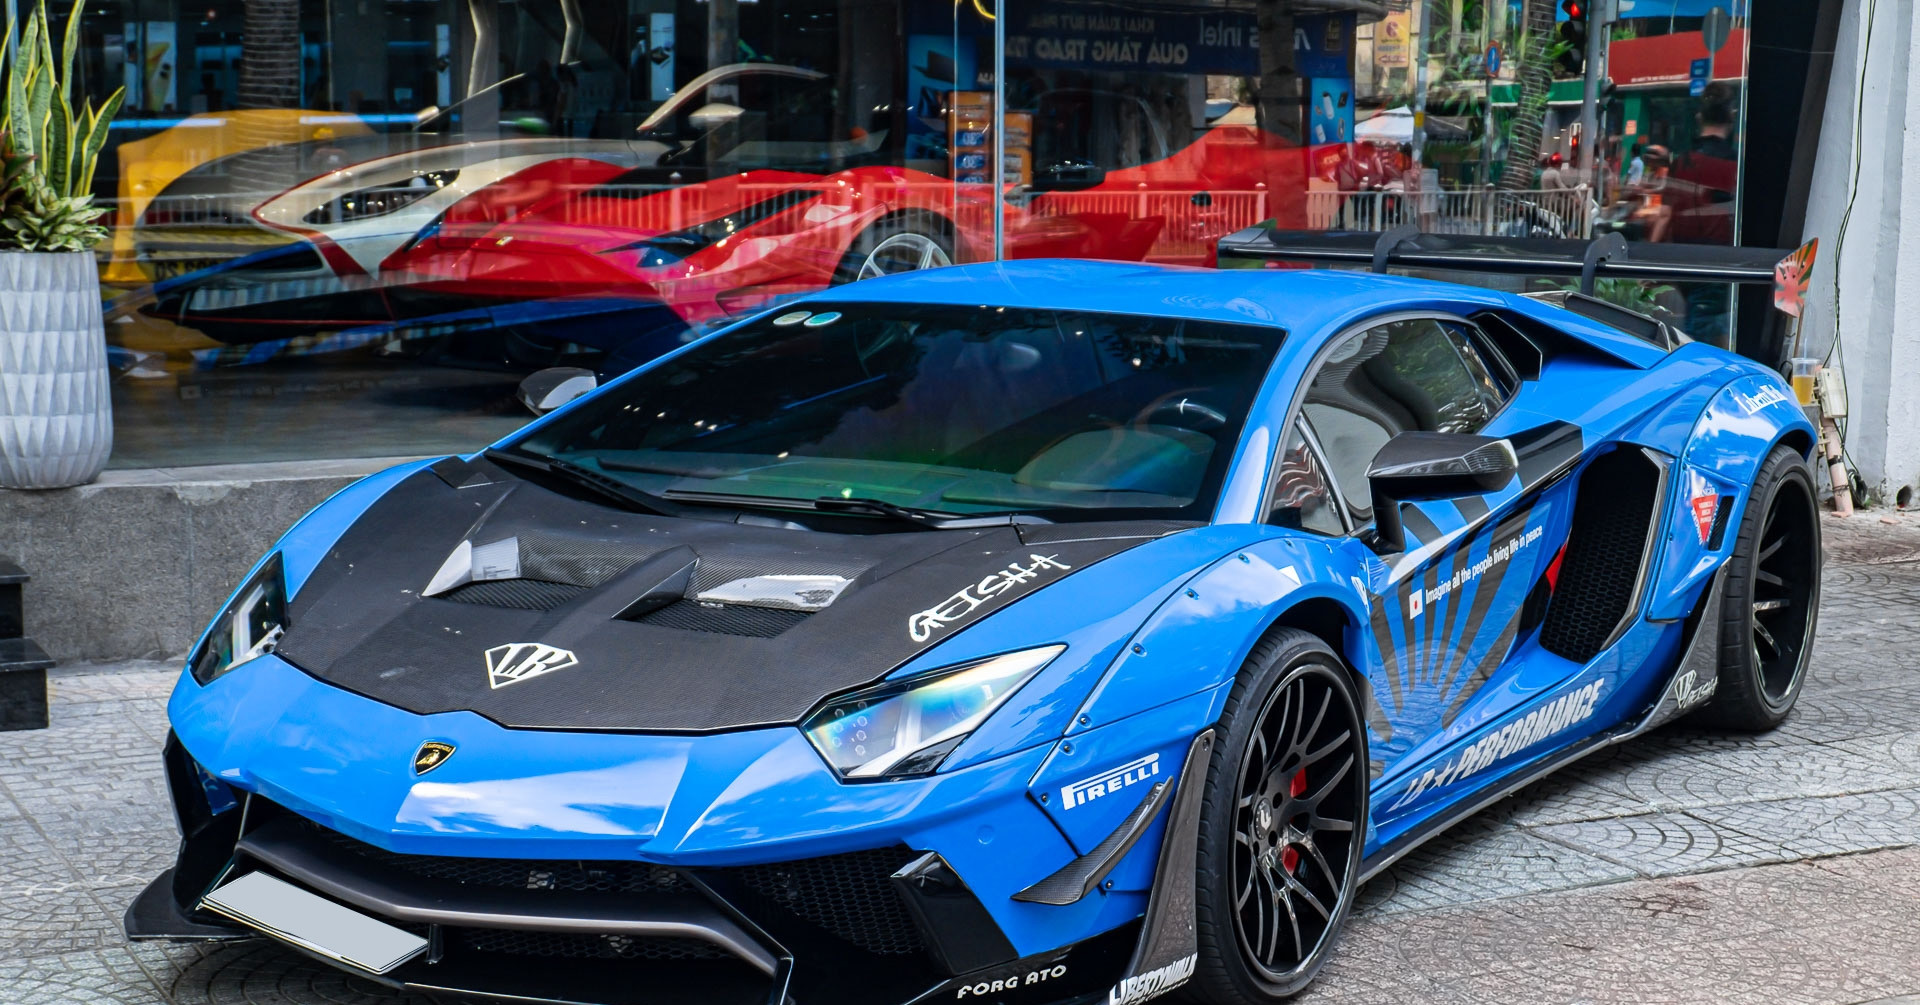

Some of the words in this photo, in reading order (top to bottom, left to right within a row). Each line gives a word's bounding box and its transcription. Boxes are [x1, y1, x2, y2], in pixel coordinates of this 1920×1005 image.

[1425, 581, 1452, 605] Imagine
[1452, 571, 1460, 588] all
[1461, 567, 1472, 584] the
[1471, 554, 1493, 580] people
[1493, 545, 1509, 564] living
[1509, 537, 1518, 555] life
[1519, 534, 1525, 548] in
[1525, 525, 1543, 547] peace
[1446, 678, 1605, 787] PERFORMANCE
[1061, 753, 1160, 811] PIRELLI
[1025, 965, 1067, 985] ATO
